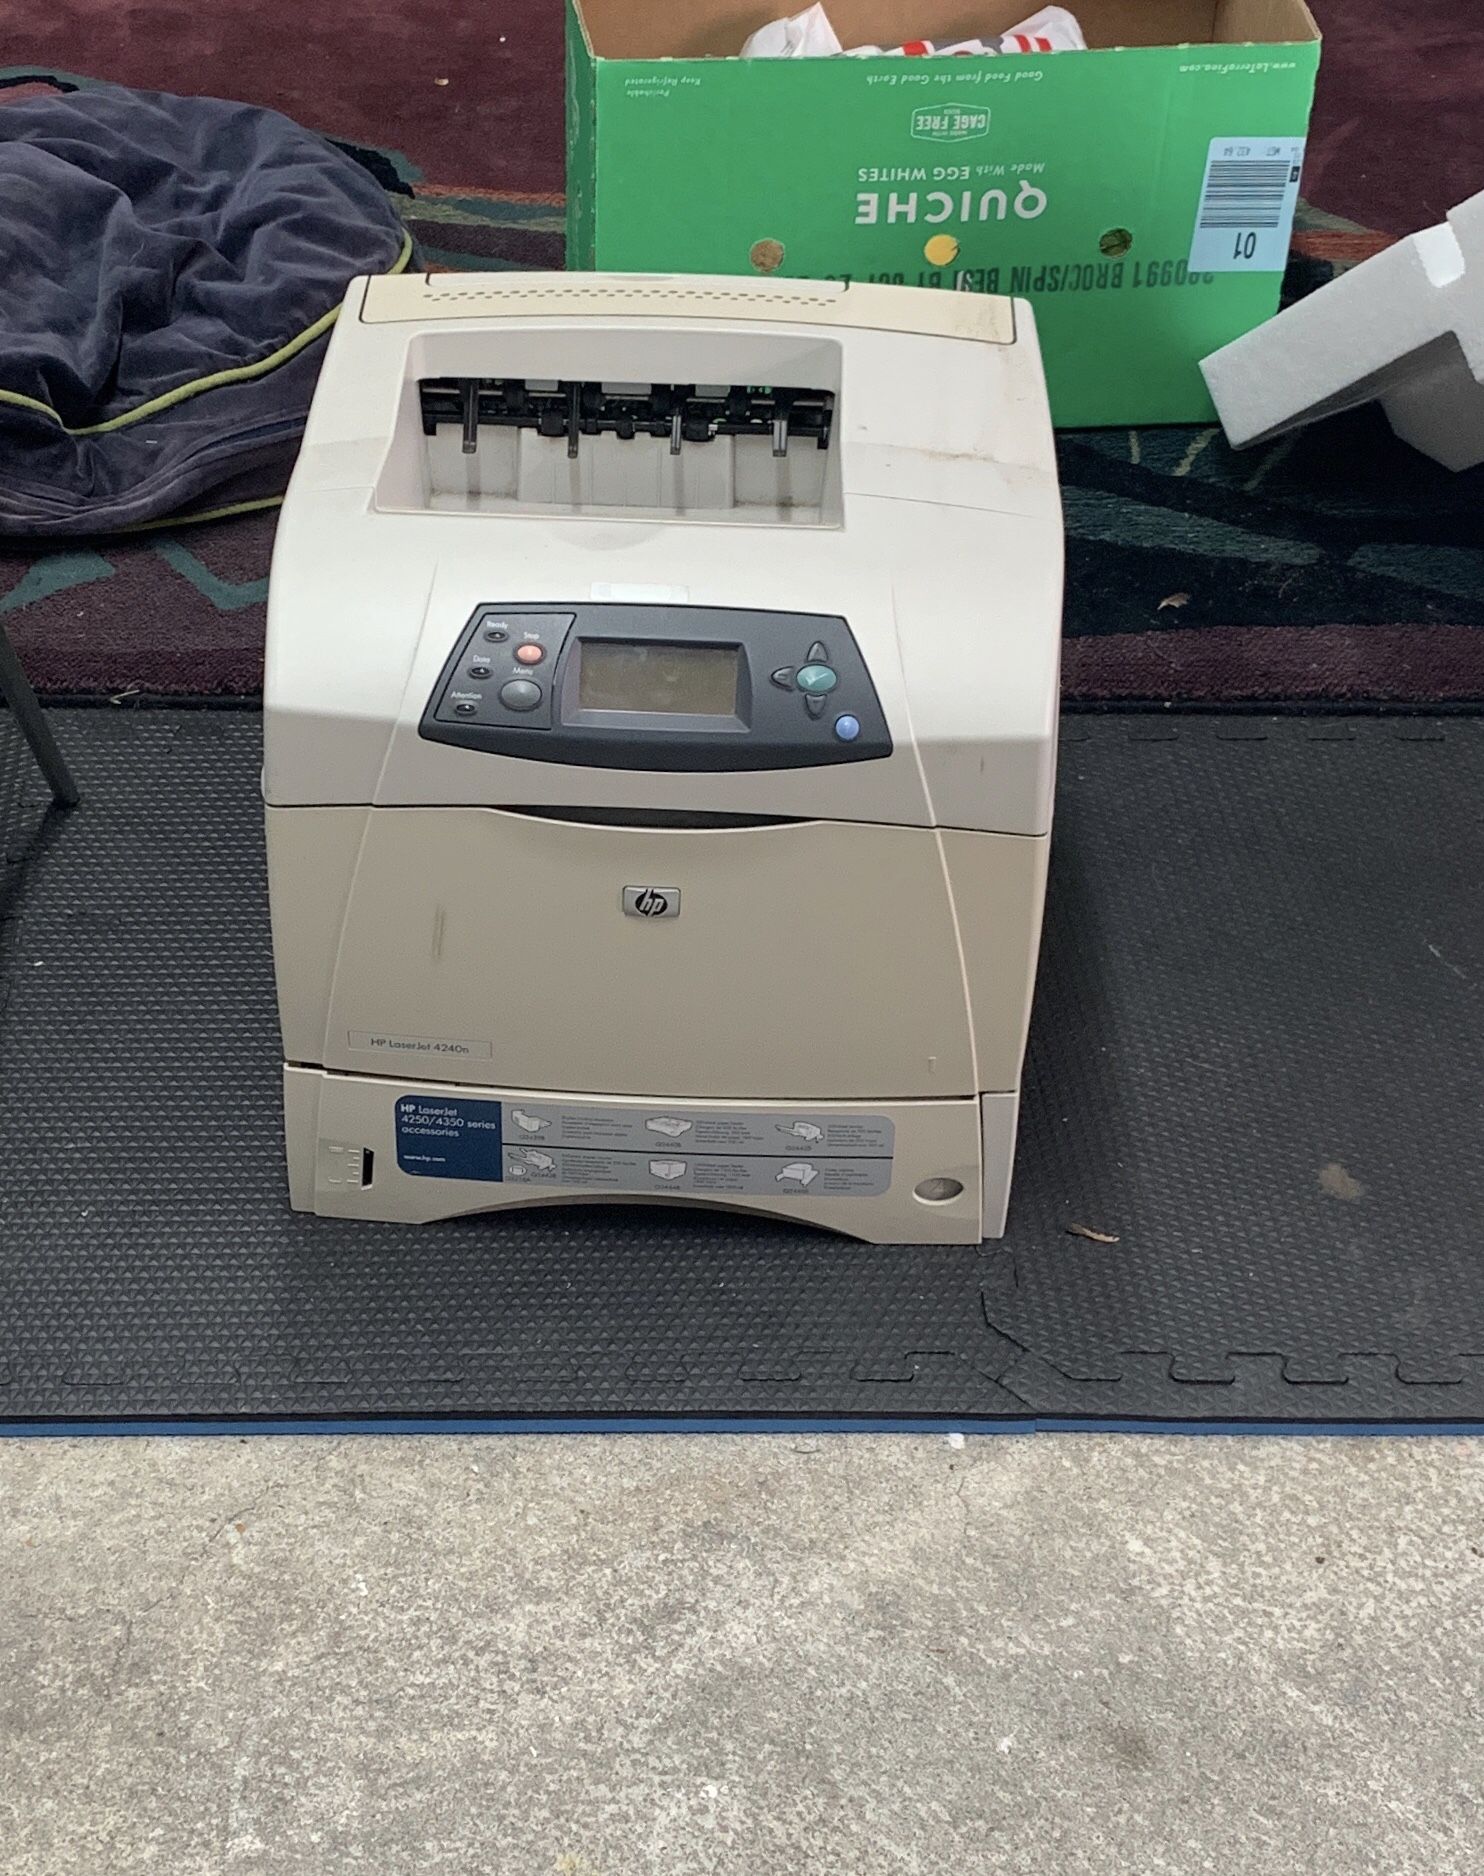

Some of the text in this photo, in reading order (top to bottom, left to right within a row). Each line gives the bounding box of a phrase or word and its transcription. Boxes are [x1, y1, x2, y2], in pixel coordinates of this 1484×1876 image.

[866, 70, 1043, 86] Good Food from the Good Earth
[915, 113, 986, 131] CAGE FREE
[857, 162, 1045, 182] Made With EGG WHITES
[854, 179, 1047, 224] QUICHE
[1233, 232, 1257, 260] 01
[1010, 261, 1124, 294] BROC/SPIN
[486, 620, 508, 630] Ready
[512, 667, 534, 676] Menu
[451, 691, 482, 700] Attention
[635, 888, 668, 917] hp
[370, 1037, 470, 1054] HP LaserJet 4240n
[400, 1103, 458, 1117] HP LaserJet
[401, 1114, 496, 1130] 4250/4350 series
[401, 1126, 460, 1138] accessories
